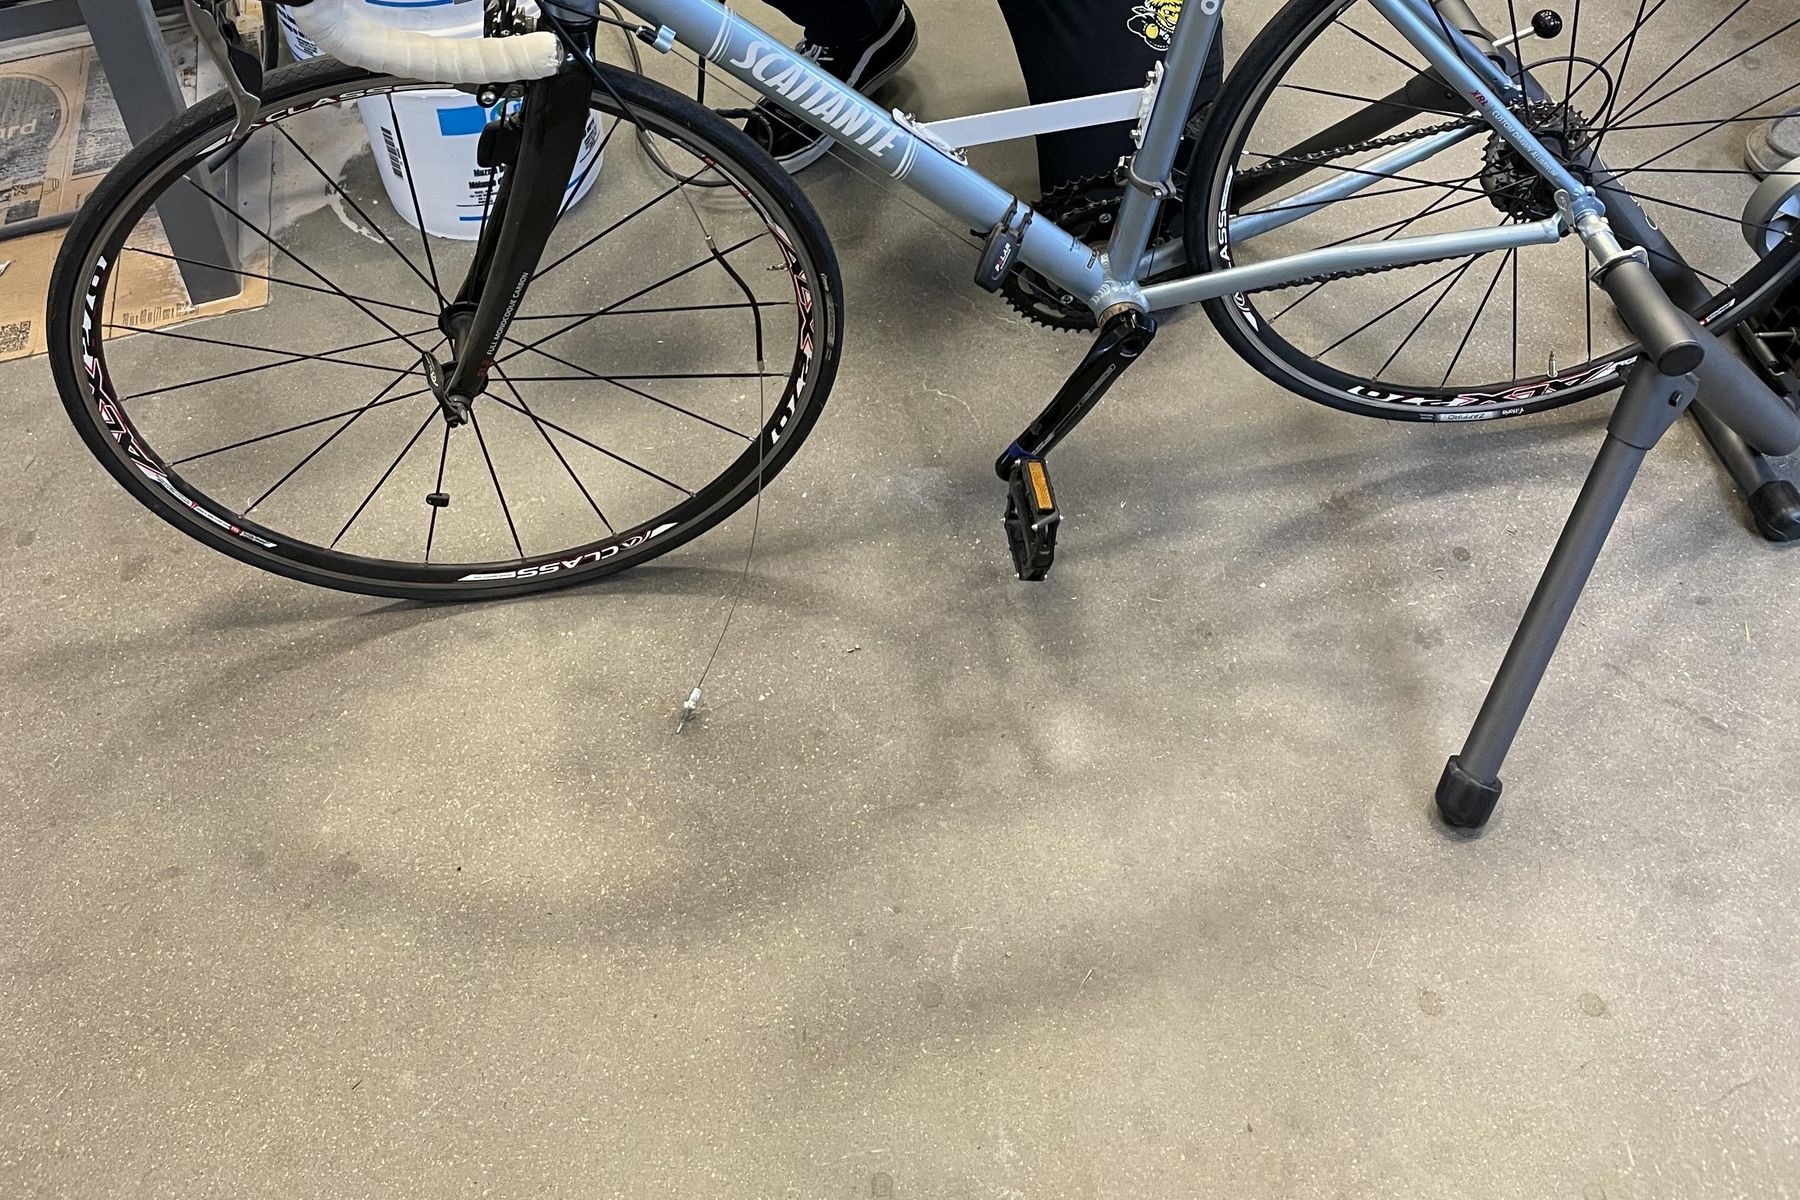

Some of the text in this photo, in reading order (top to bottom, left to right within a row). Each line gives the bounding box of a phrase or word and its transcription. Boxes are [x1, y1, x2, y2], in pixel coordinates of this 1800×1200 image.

[730, 40, 904, 158] SCATTANTE
[1492, 110, 1515, 134] CUSTOM
[486, 271, 530, 356] FULL MONOCOQUE CARBON
